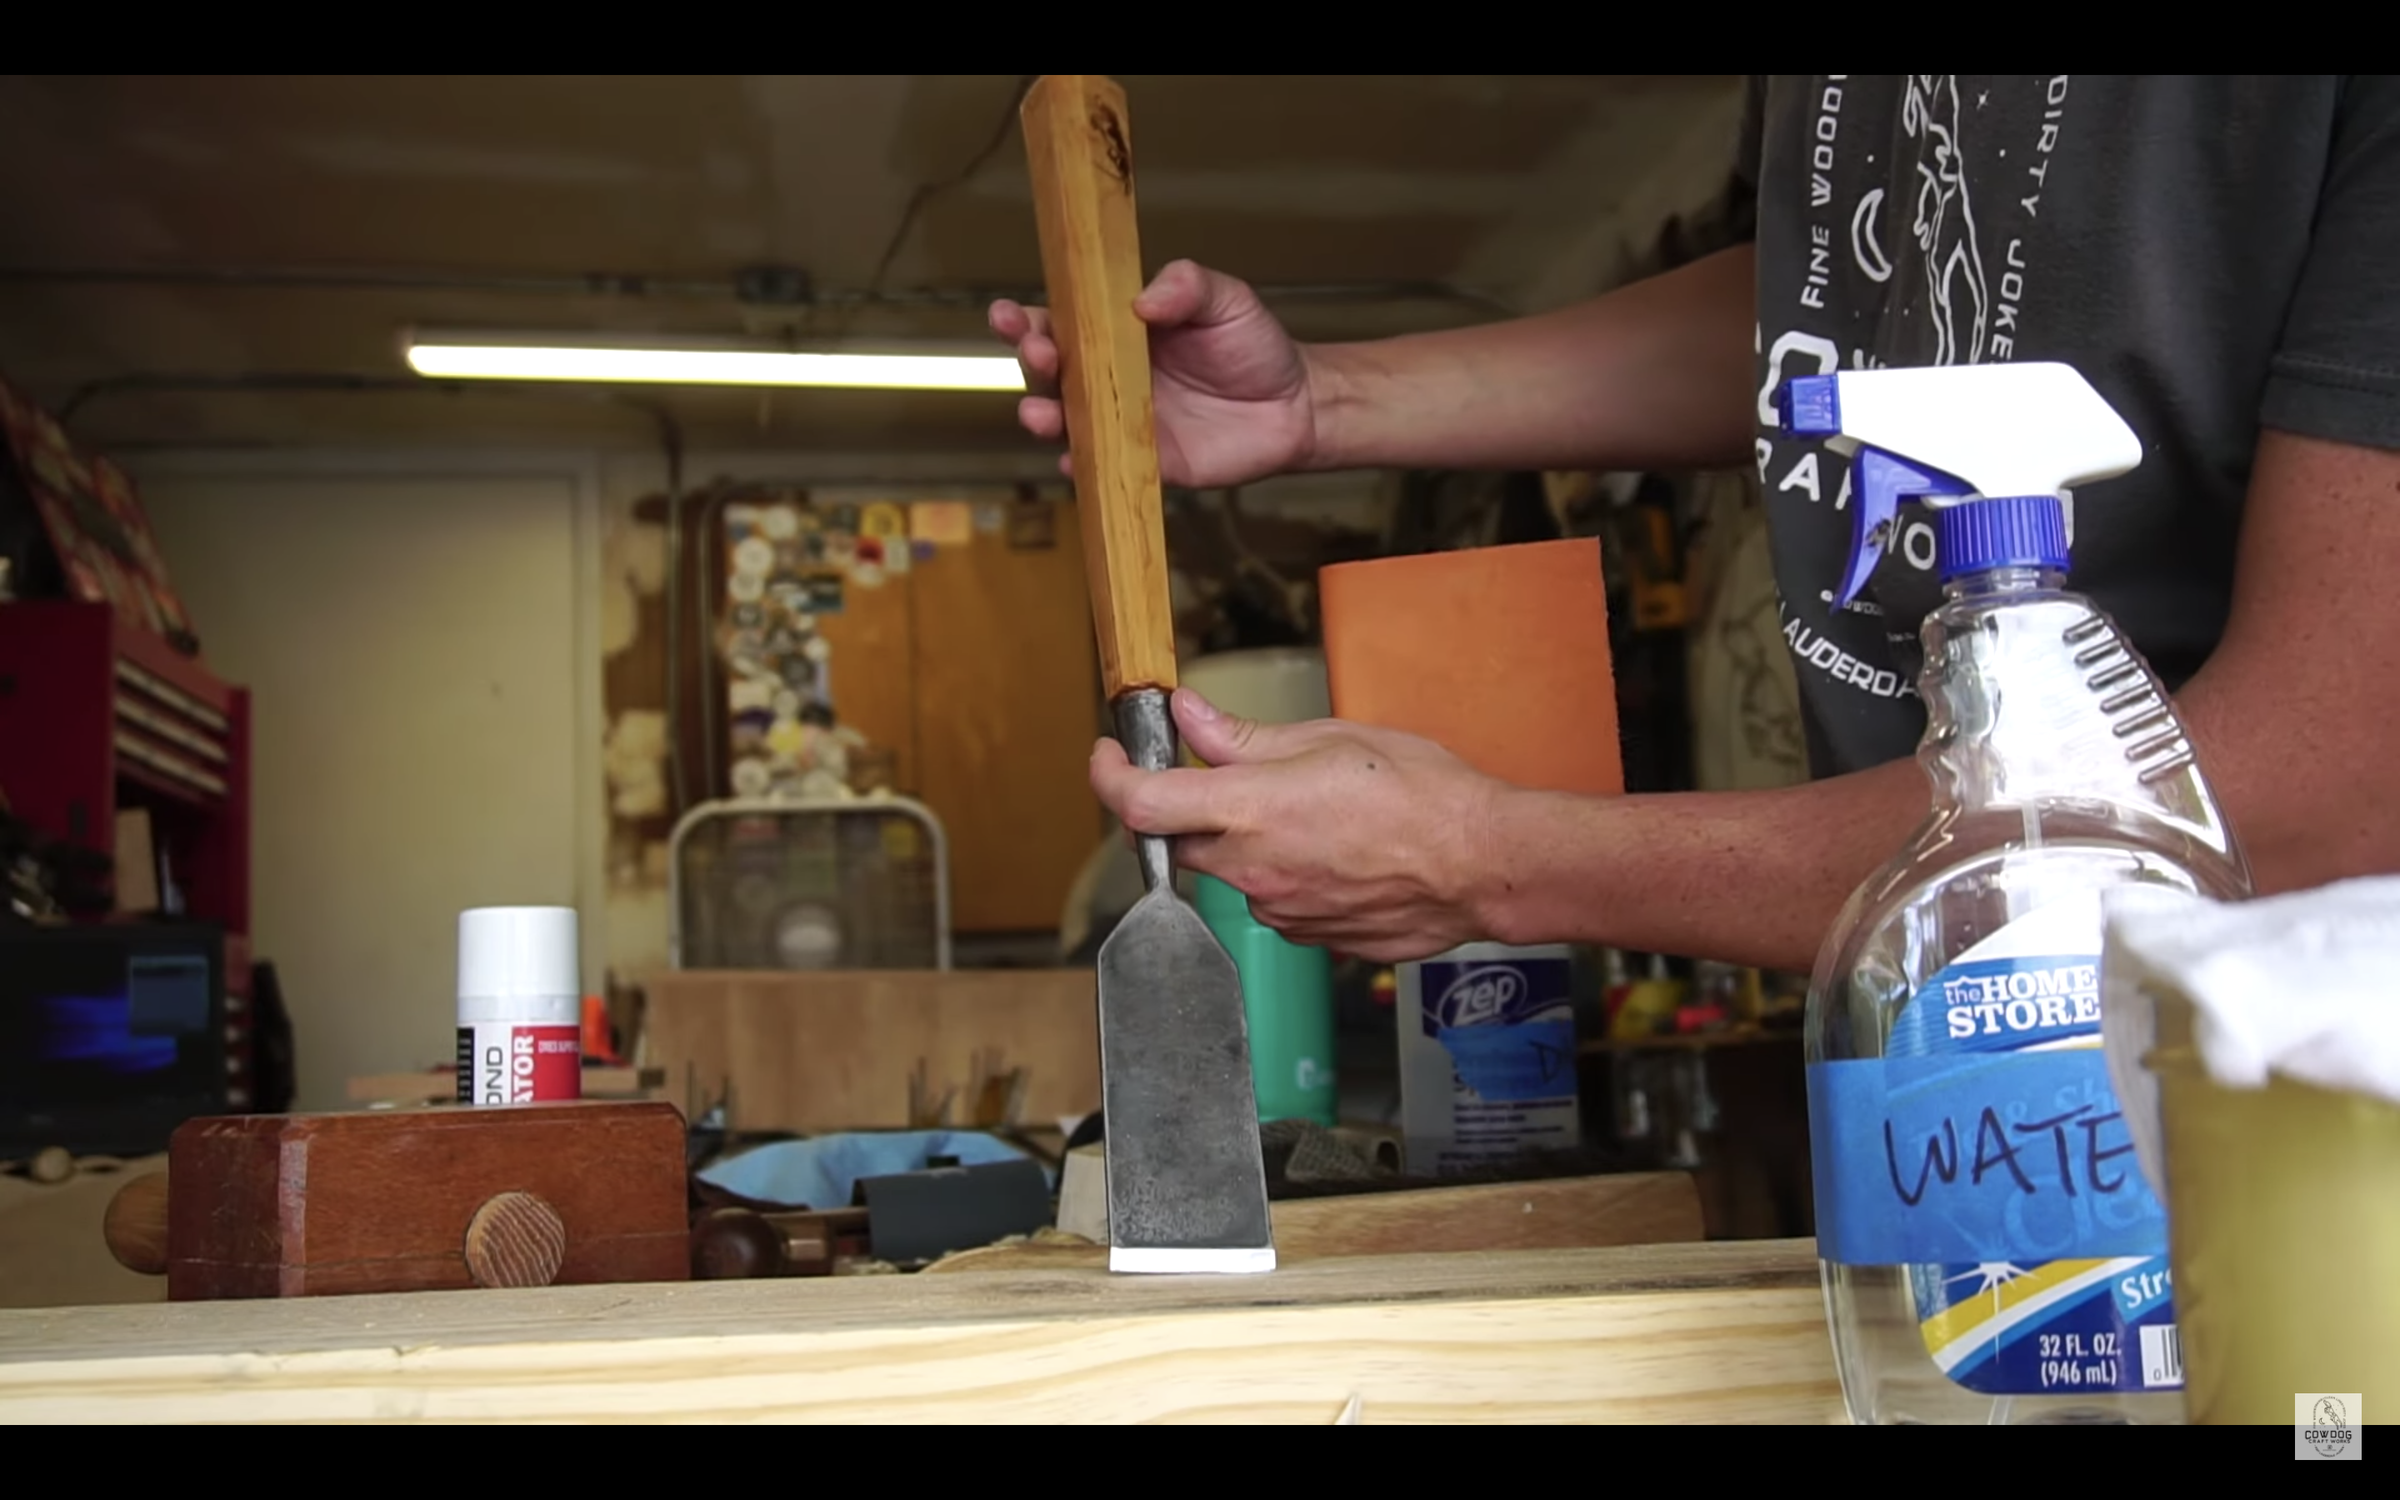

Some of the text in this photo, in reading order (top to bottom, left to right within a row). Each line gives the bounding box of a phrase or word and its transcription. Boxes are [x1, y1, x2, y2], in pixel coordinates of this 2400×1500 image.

[1801, 75, 1847, 308] FINE WOOD
[1990, 75, 2068, 364] DIRTY JOKE
[1944, 964, 2099, 1005] the HOME
[1946, 992, 2102, 1039] STORE
[486, 1046, 502, 1105] OND
[513, 1035, 534, 1105] ATOR
[1884, 1105, 2135, 1206] WATE
[2039, 1332, 2122, 1358] 32 FL. OZ.
[2041, 1358, 2117, 1388] (946 mL)
